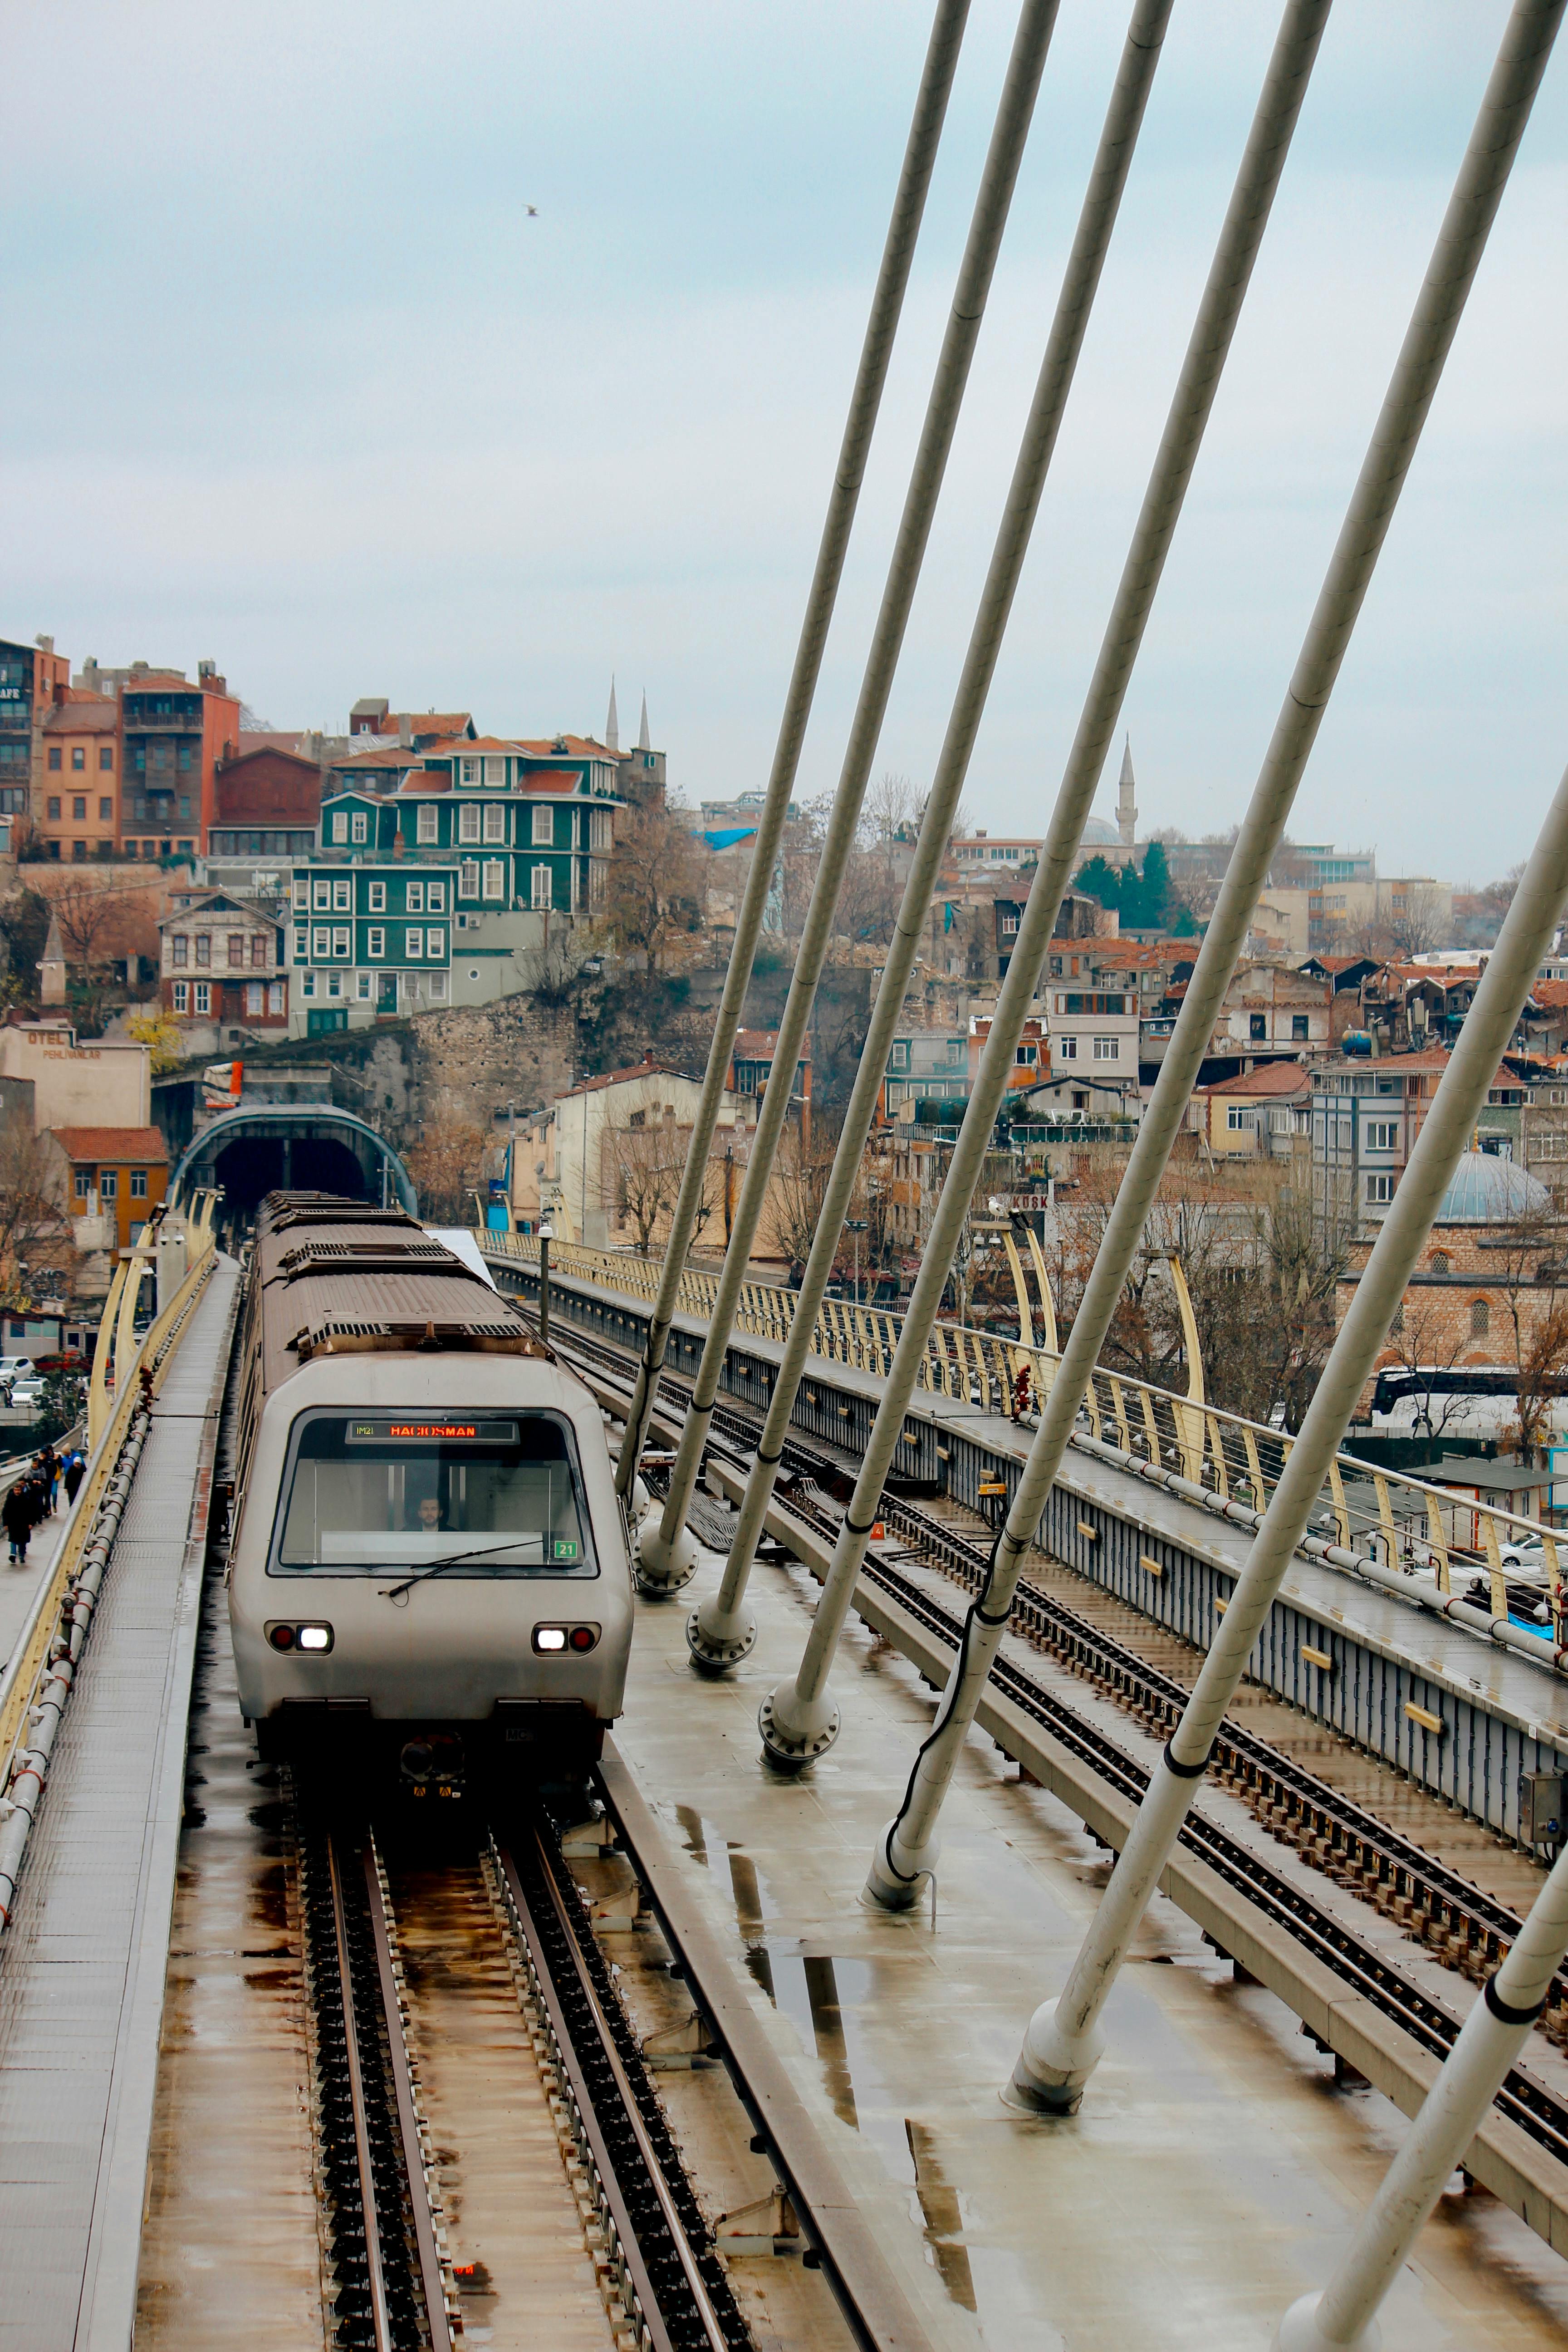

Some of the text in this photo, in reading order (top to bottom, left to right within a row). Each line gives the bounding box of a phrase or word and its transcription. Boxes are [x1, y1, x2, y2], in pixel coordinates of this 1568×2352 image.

[0, 688, 20, 699] AFE
[29, 1032, 65, 1044] OTEL
[560, 1545, 572, 1554] 21
